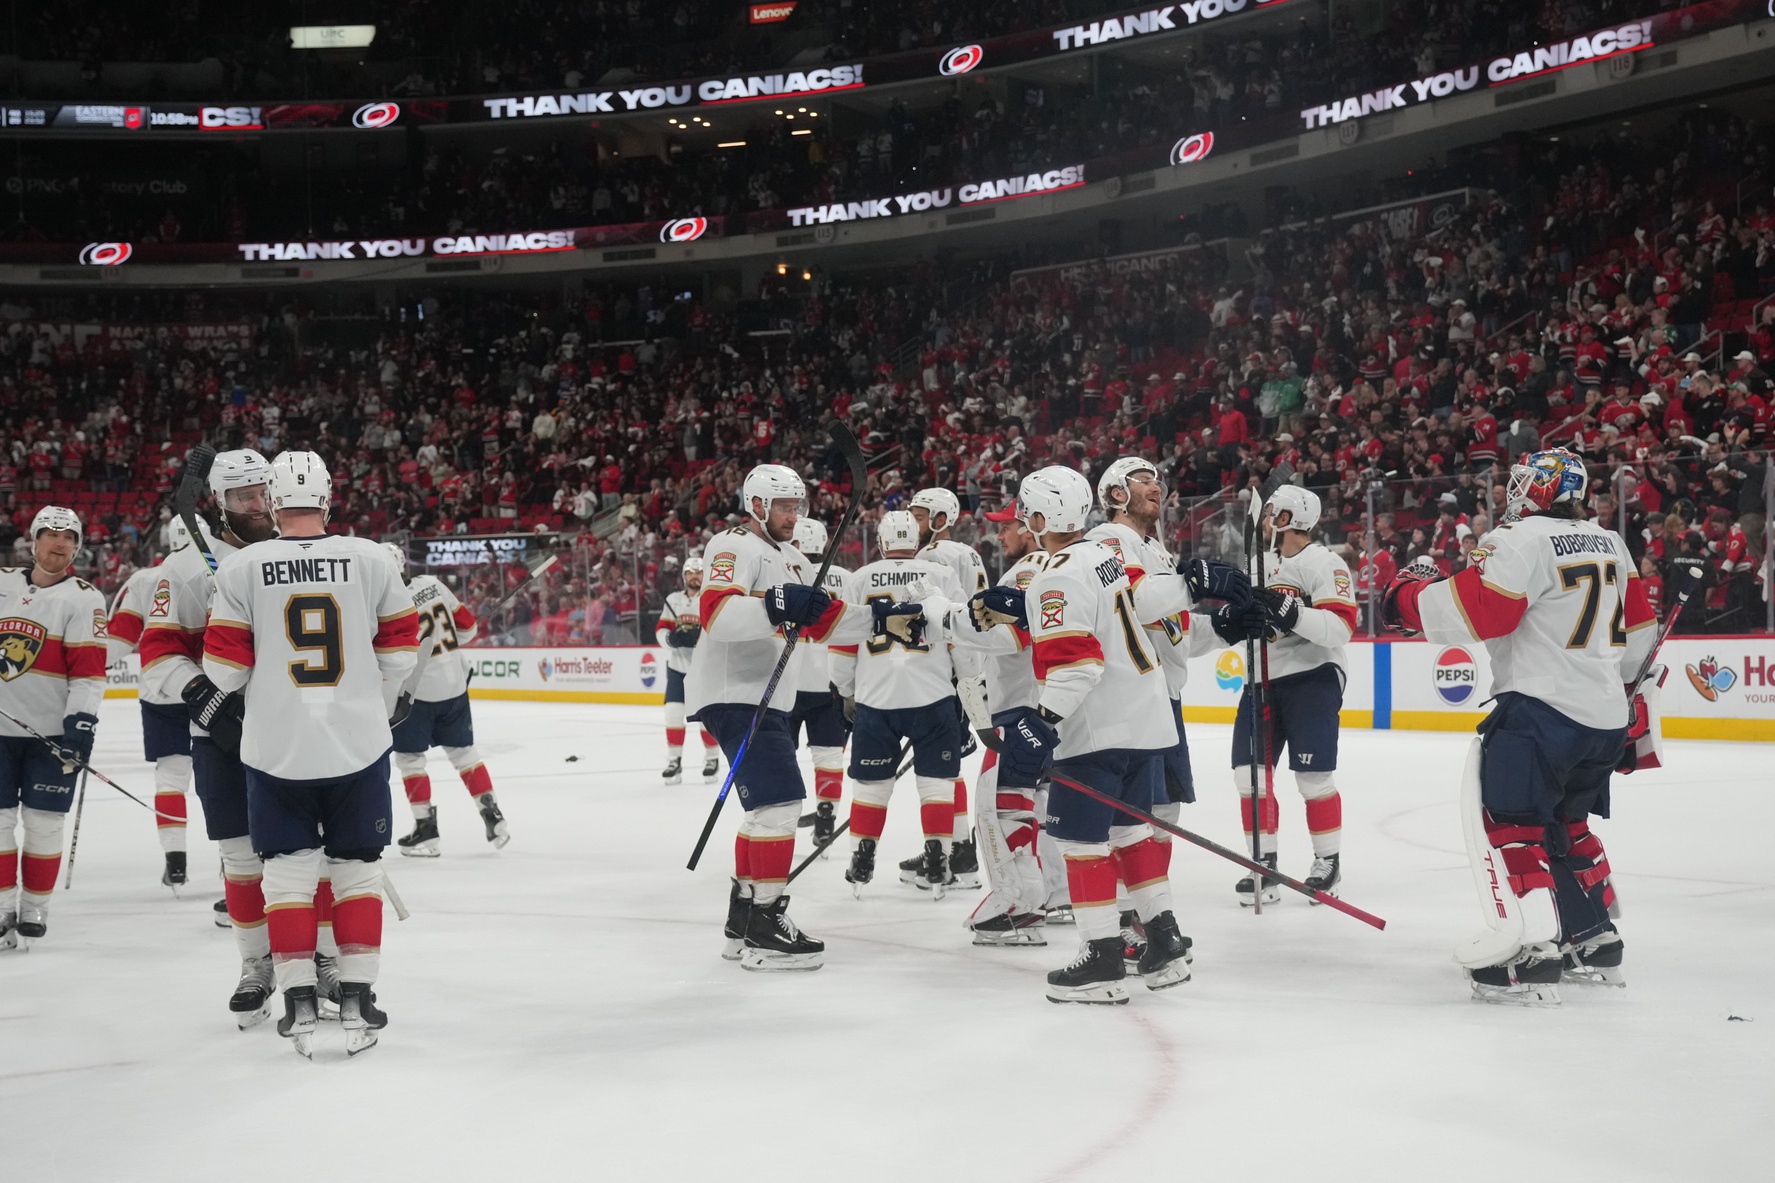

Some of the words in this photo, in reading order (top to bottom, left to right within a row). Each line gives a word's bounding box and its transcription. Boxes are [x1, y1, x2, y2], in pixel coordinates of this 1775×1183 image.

[1053, 6, 1176, 50] THANK
[1301, 84, 1406, 129] THANK
[1410, 65, 1479, 101] YOU
[1487, 21, 1653, 82] CANIACS!
[484, 92, 614, 118] THANK
[617, 85, 691, 109] YOU
[699, 64, 864, 100] CANIACS!
[150, 180, 187, 193] Club
[787, 197, 892, 226] THANK
[895, 188, 951, 214] YOU
[958, 164, 1084, 202] CANIACS!
[239, 241, 355, 261] THANK
[359, 239, 425, 257] YOU
[433, 231, 575, 254] CANIACS!
[298, 474, 305, 485] 9
[426, 540, 487, 552] THANK
[489, 538, 526, 550] YOU
[1549, 533, 1618, 556] BOBROVSKY
[262, 559, 351, 586] BENNETT
[1557, 560, 1628, 649] 72
[284, 593, 345, 688] 9
[555, 657, 582, 673] Harris
[582, 657, 613, 674] Teeter
[1437, 669, 1474, 681] PEPSI
[860, 757, 892, 766] CCM
[33, 783, 70, 794] CCM
[1484, 849, 1508, 919] TRUE
